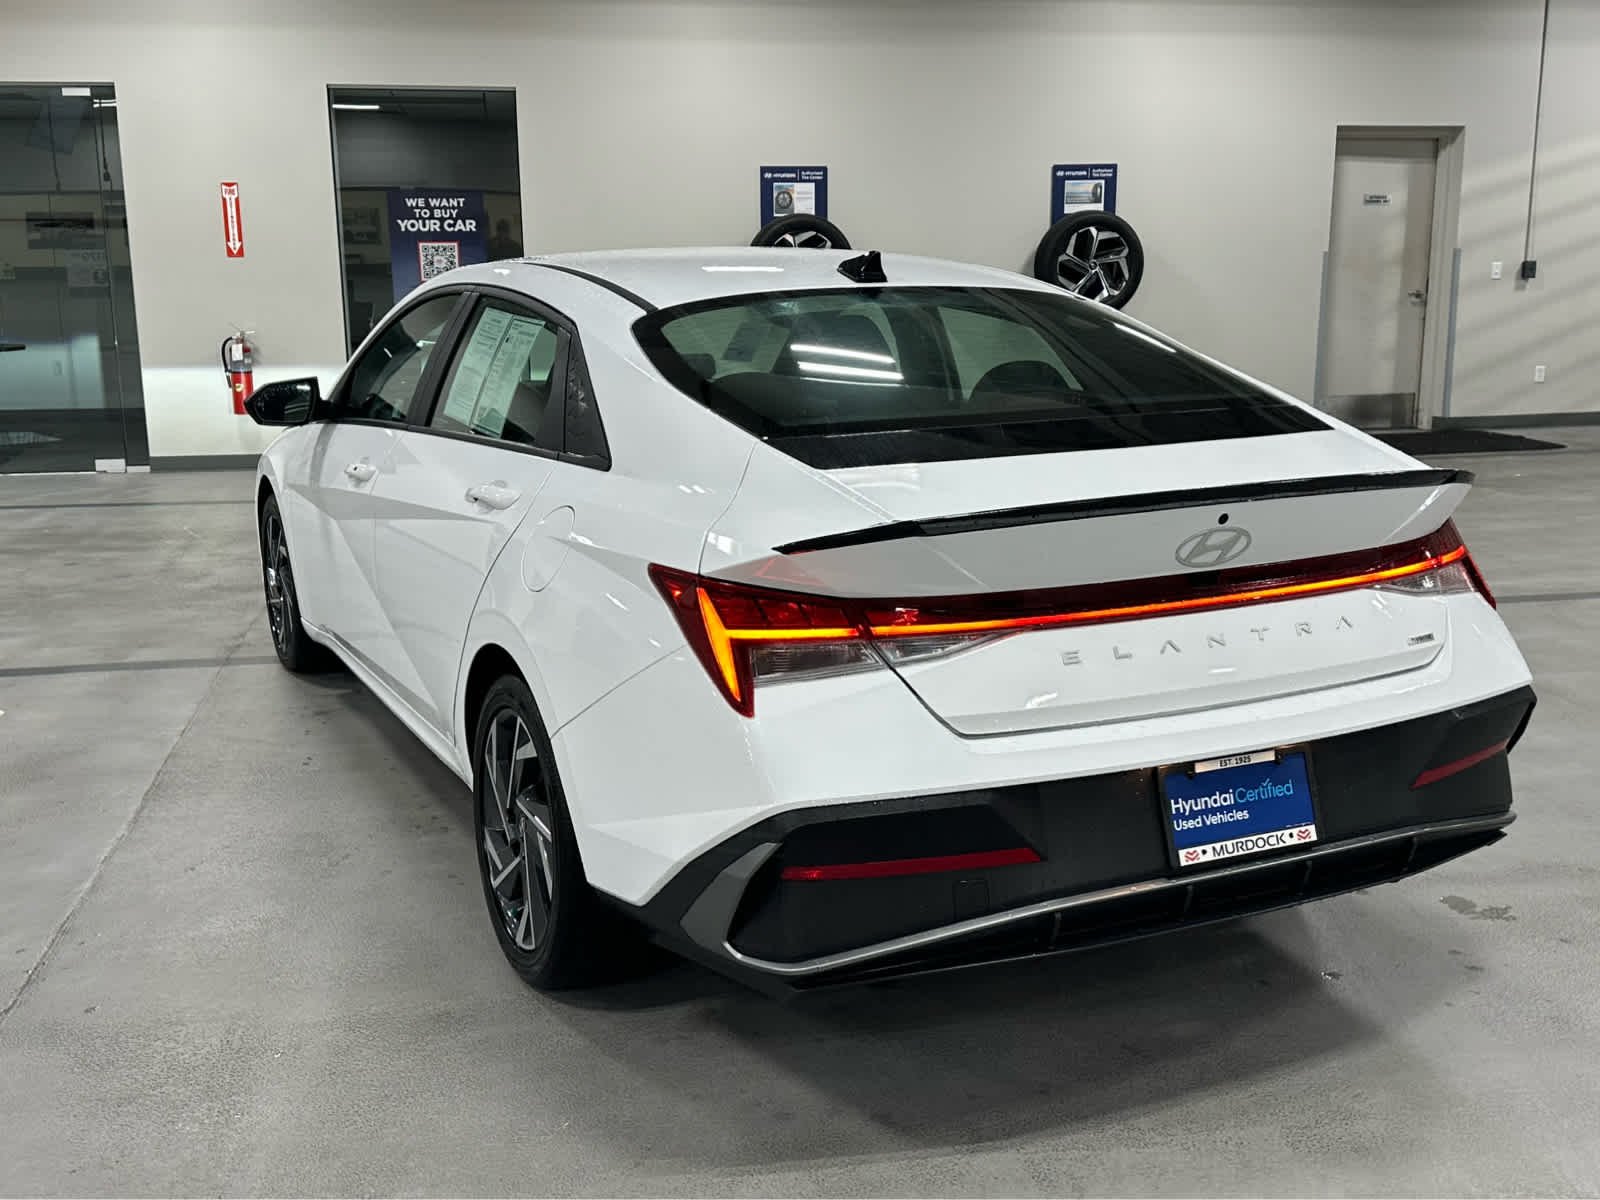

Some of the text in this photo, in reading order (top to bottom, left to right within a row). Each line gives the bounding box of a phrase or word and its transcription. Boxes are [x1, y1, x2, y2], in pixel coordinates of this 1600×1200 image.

[404, 197, 465, 207] WE WANT
[414, 209, 459, 218] TO BUY
[396, 219, 477, 232] YOUR CAR
[1062, 615, 1354, 666] ELANTRA
[1234, 755, 1252, 765] 1925
[1173, 809, 1250, 831] Used Vehicles
[1212, 832, 1287, 857] MURDOCK
